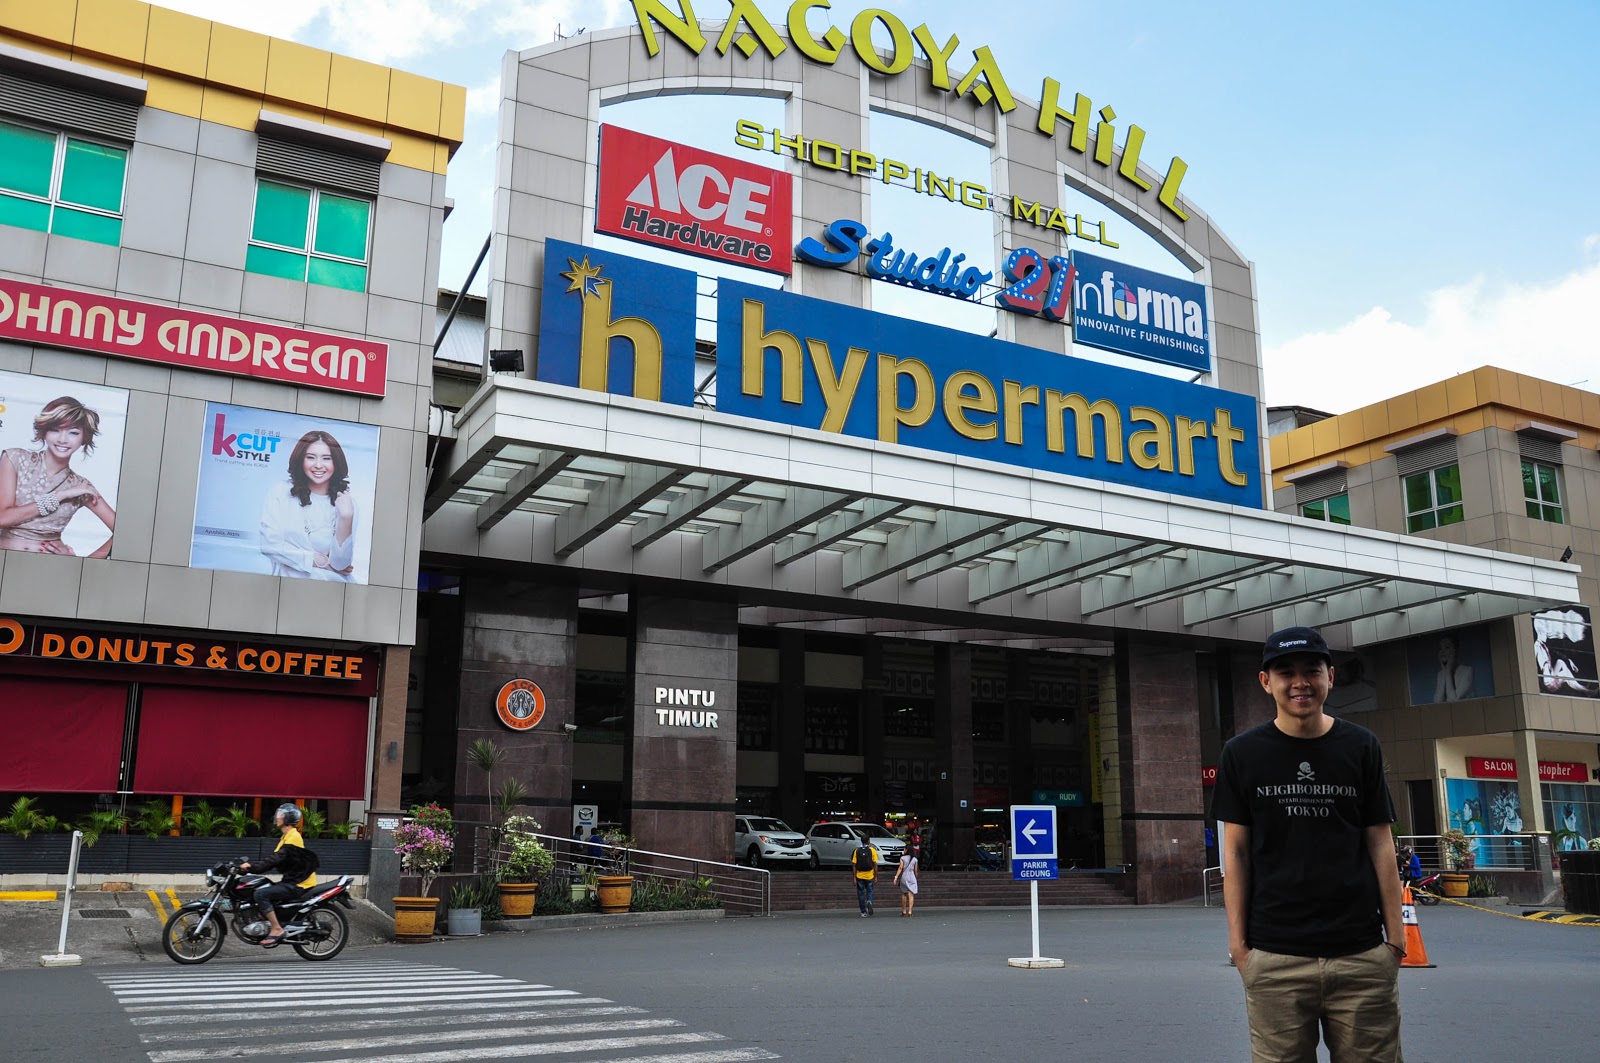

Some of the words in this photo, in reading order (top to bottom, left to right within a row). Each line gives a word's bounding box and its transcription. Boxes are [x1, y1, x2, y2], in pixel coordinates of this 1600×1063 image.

[631, 0, 1017, 114] NAGOYA
[625, 146, 771, 233] ACE
[736, 119, 988, 210] SHOPPING
[1012, 195, 1120, 249] MALL
[621, 205, 772, 262] Hardware
[795, 219, 993, 299] Studio
[995, 247, 1076, 321] 21
[1075, 271, 1203, 339] informa
[1076, 316, 1137, 338] INNOVATIVE
[1140, 330, 1205, 355] FURNISHINGS
[741, 298, 1247, 486] hypermart
[237, 450, 271, 462] STYLE
[41, 633, 195, 667] DONUTS
[206, 645, 228, 669] &
[238, 648, 363, 679] COFFEE
[655, 687, 715, 707] PINTU
[655, 708, 719, 728] TIMUR
[1484, 761, 1514, 771] SALON
[1285, 805, 1329, 817] TOKYO
[1020, 870, 1051, 878] GEDUNG
[1023, 861, 1048, 869] PARKIR
